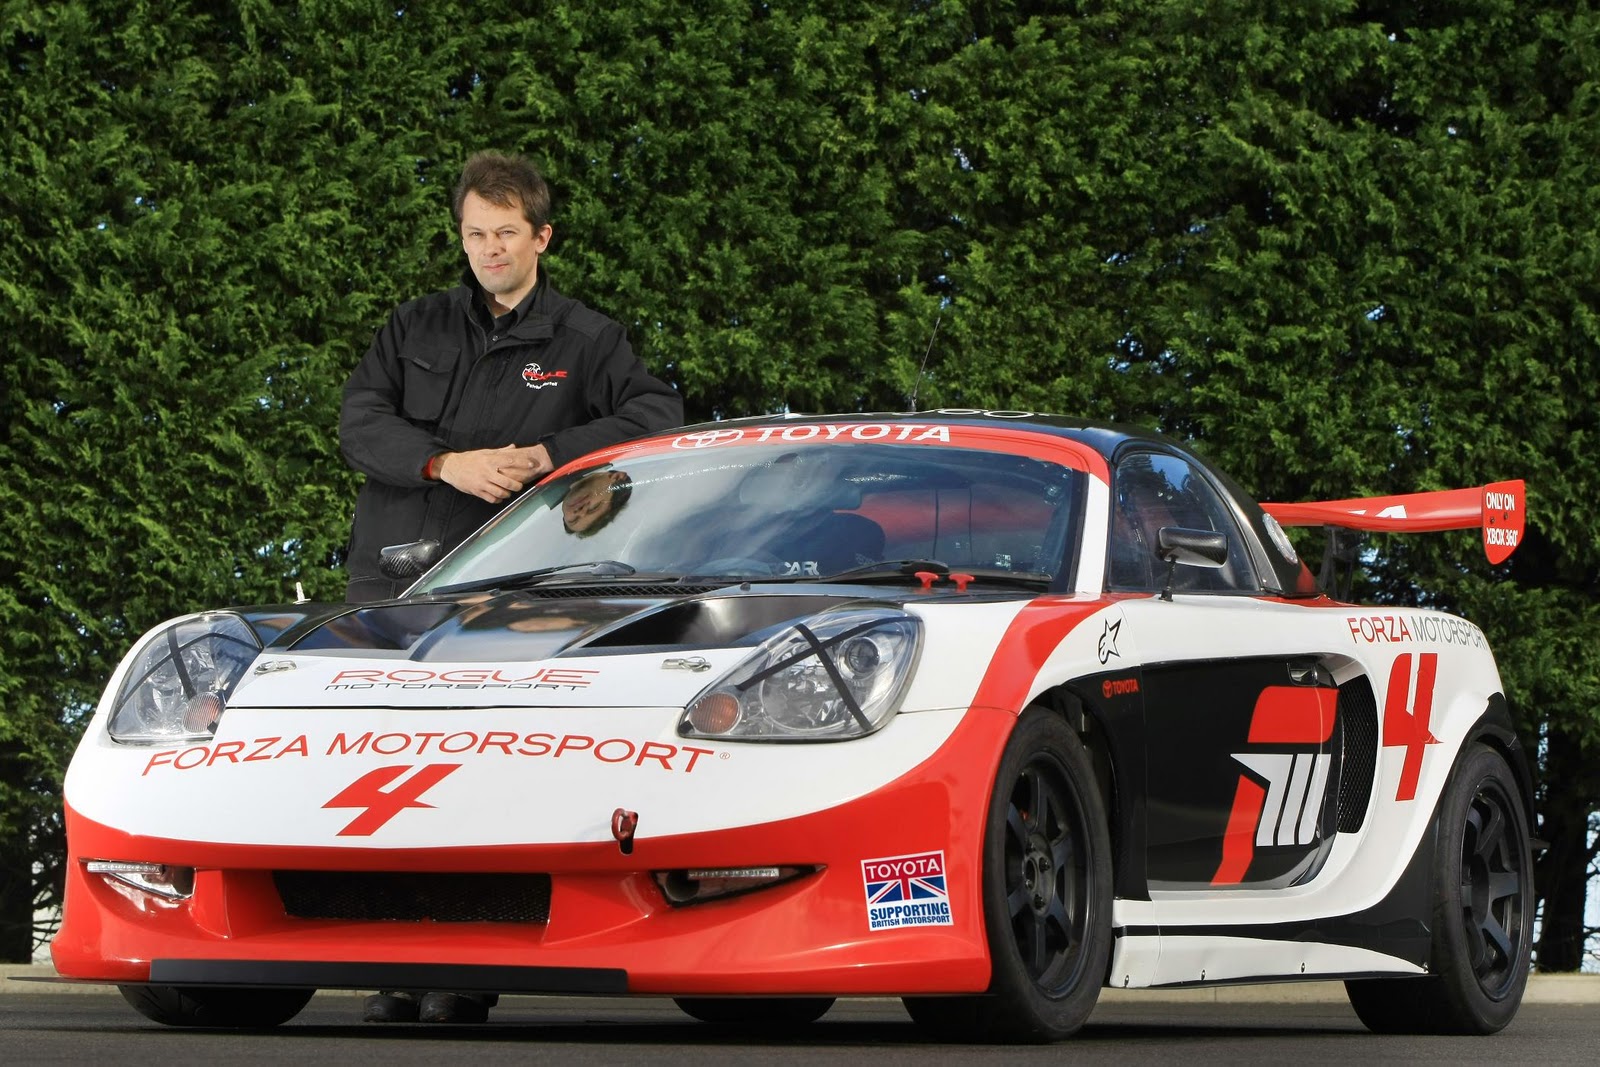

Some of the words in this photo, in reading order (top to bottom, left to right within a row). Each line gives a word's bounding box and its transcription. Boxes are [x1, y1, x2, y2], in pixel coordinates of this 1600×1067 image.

[754, 424, 951, 442] TOYOTA
[1486, 492, 1504, 510] ONLY
[1504, 493, 1515, 511] ON
[1486, 527, 1505, 546] XBOX
[1347, 616, 1412, 643] FORZA
[1411, 616, 1488, 650] MOTORSPOR
[331, 669, 600, 684] ROGUE
[325, 682, 588, 691] MOTORSPORT
[1112, 679, 1139, 695] TOYOTA
[1382, 653, 1444, 801] 4
[142, 735, 309, 776] FORZA
[326, 731, 714, 773] MOTORSPORT
[320, 763, 464, 836] 4
[866, 858, 940, 879] TOYOTA
[870, 902, 949, 920] SUPPORTING
[871, 918, 900, 928] BRITISH
[902, 915, 950, 925] MOTORSPORT
